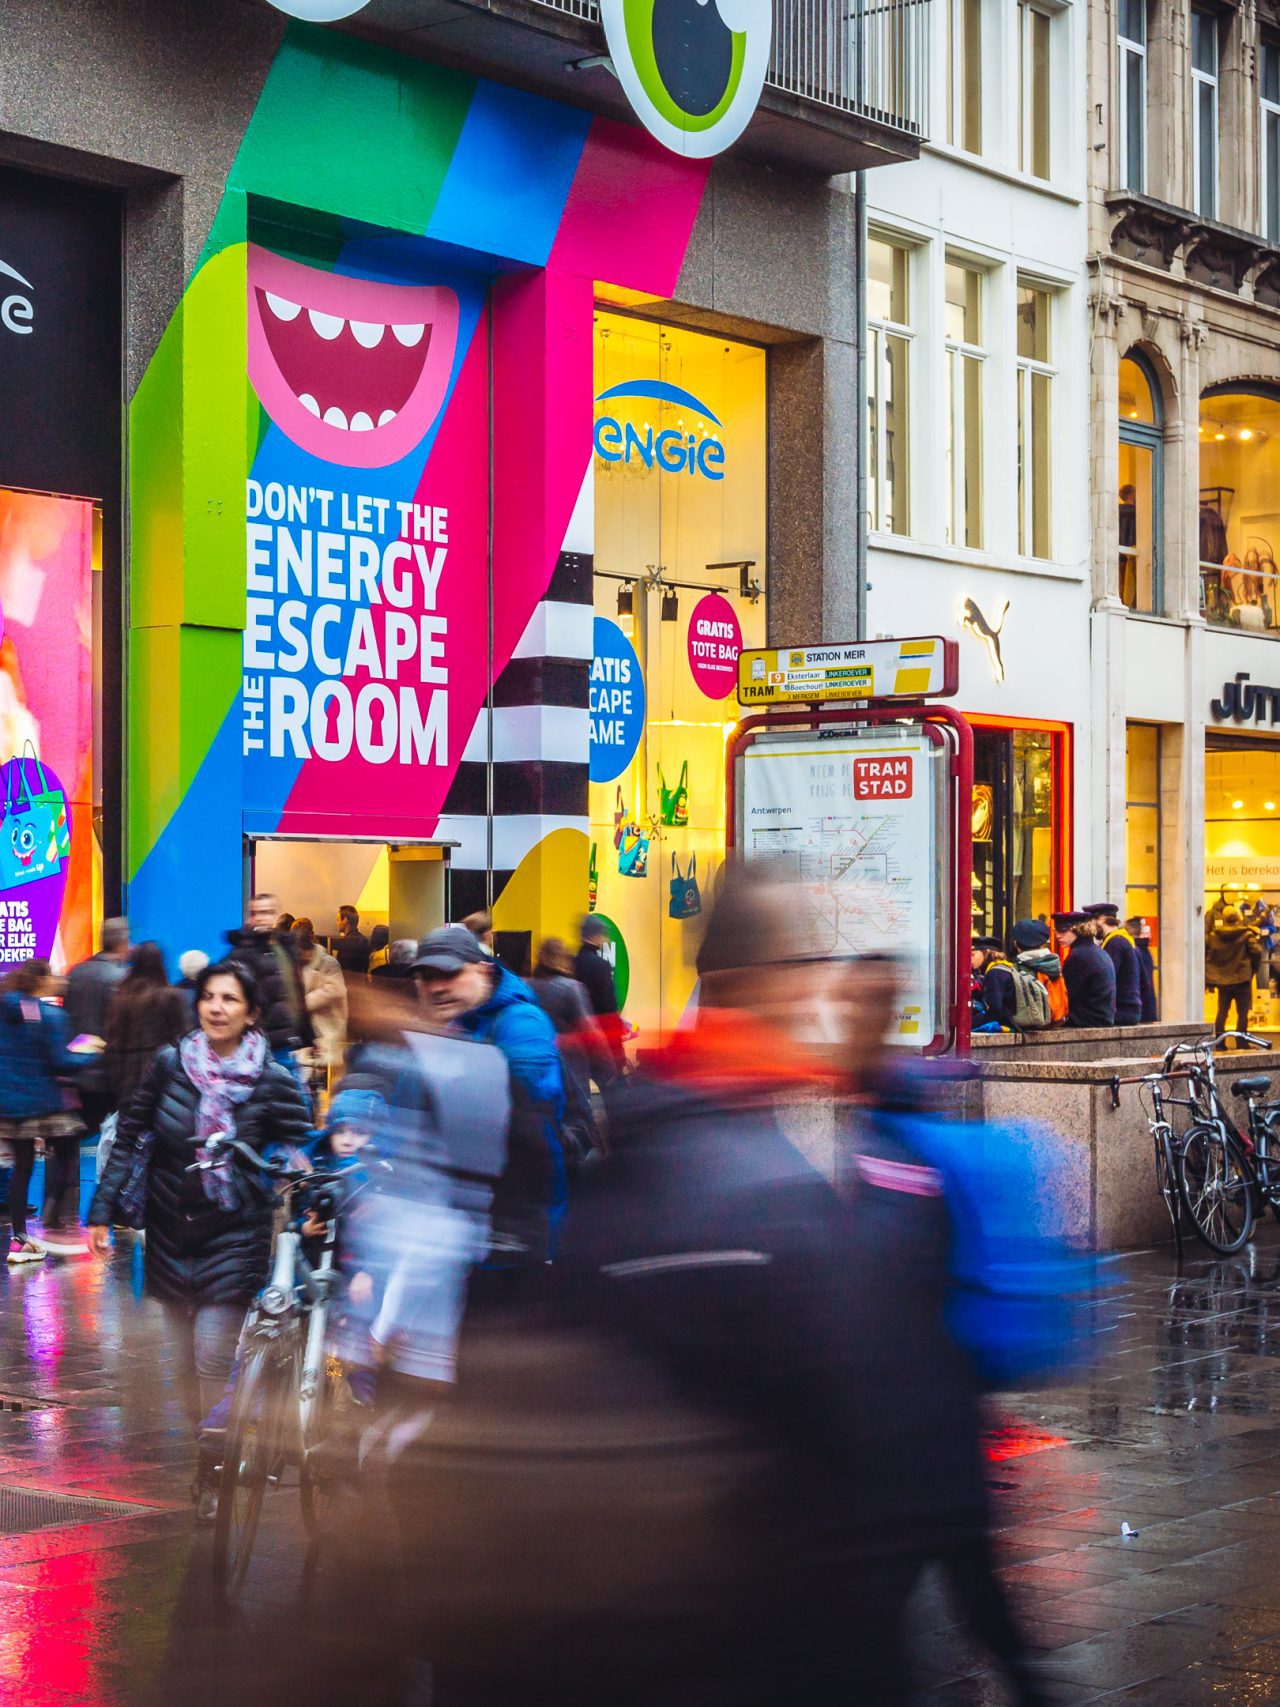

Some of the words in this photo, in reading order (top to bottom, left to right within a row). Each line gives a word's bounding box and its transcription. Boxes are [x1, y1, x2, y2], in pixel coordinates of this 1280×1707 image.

[246, 478, 334, 527] DON'T
[341, 492, 390, 535] LET
[396, 501, 449, 544] THE
[246, 521, 449, 612] ENERGY
[696, 619, 734, 640] GRATIS
[242, 596, 449, 685] ESCAPE
[691, 640, 717, 659] TOTE
[718, 644, 739, 662] BAG
[806, 651, 841, 663] STATION
[843, 649, 866, 660] MEIR
[589, 656, 632, 685] ATIS
[773, 672, 782, 684] 9
[787, 671, 821, 681] Eksterlaar
[743, 685, 775, 698] TRAM
[825, 679, 868, 689] LINKEROEVER
[242, 674, 264, 757] THE
[270, 676, 449, 767] ROOM
[589, 718, 625, 746] AME
[857, 761, 908, 777] TRAM
[859, 780, 908, 796] STAD
[751, 807, 792, 815] Antwerpen
[1206, 864, 1225, 876] Het
[1229, 864, 1238, 876] is
[7, 917, 32, 933] BAG
[7, 932, 37, 948] ELKE
